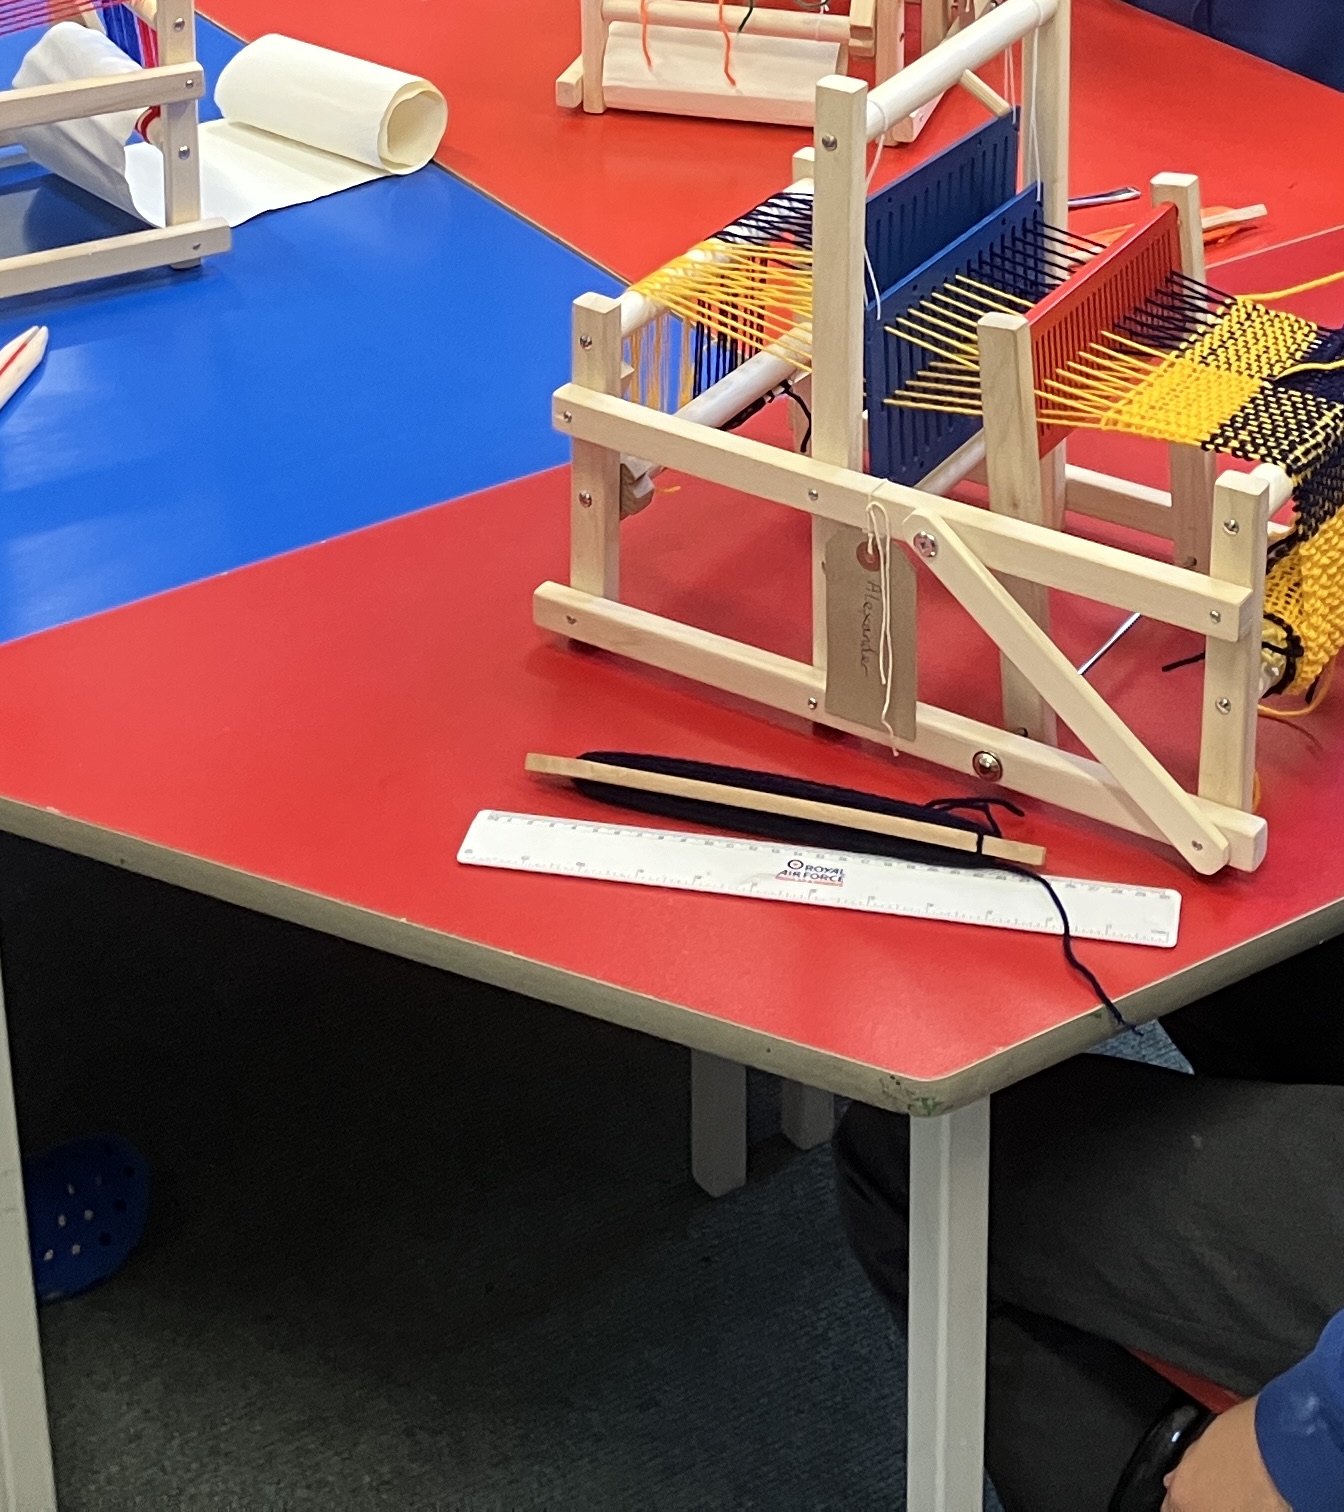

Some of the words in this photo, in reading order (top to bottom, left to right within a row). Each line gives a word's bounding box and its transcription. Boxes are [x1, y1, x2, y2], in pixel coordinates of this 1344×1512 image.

[781, 869, 801, 878] AIR
[802, 872, 843, 883] FORCE
[804, 864, 844, 876] ROYAL
